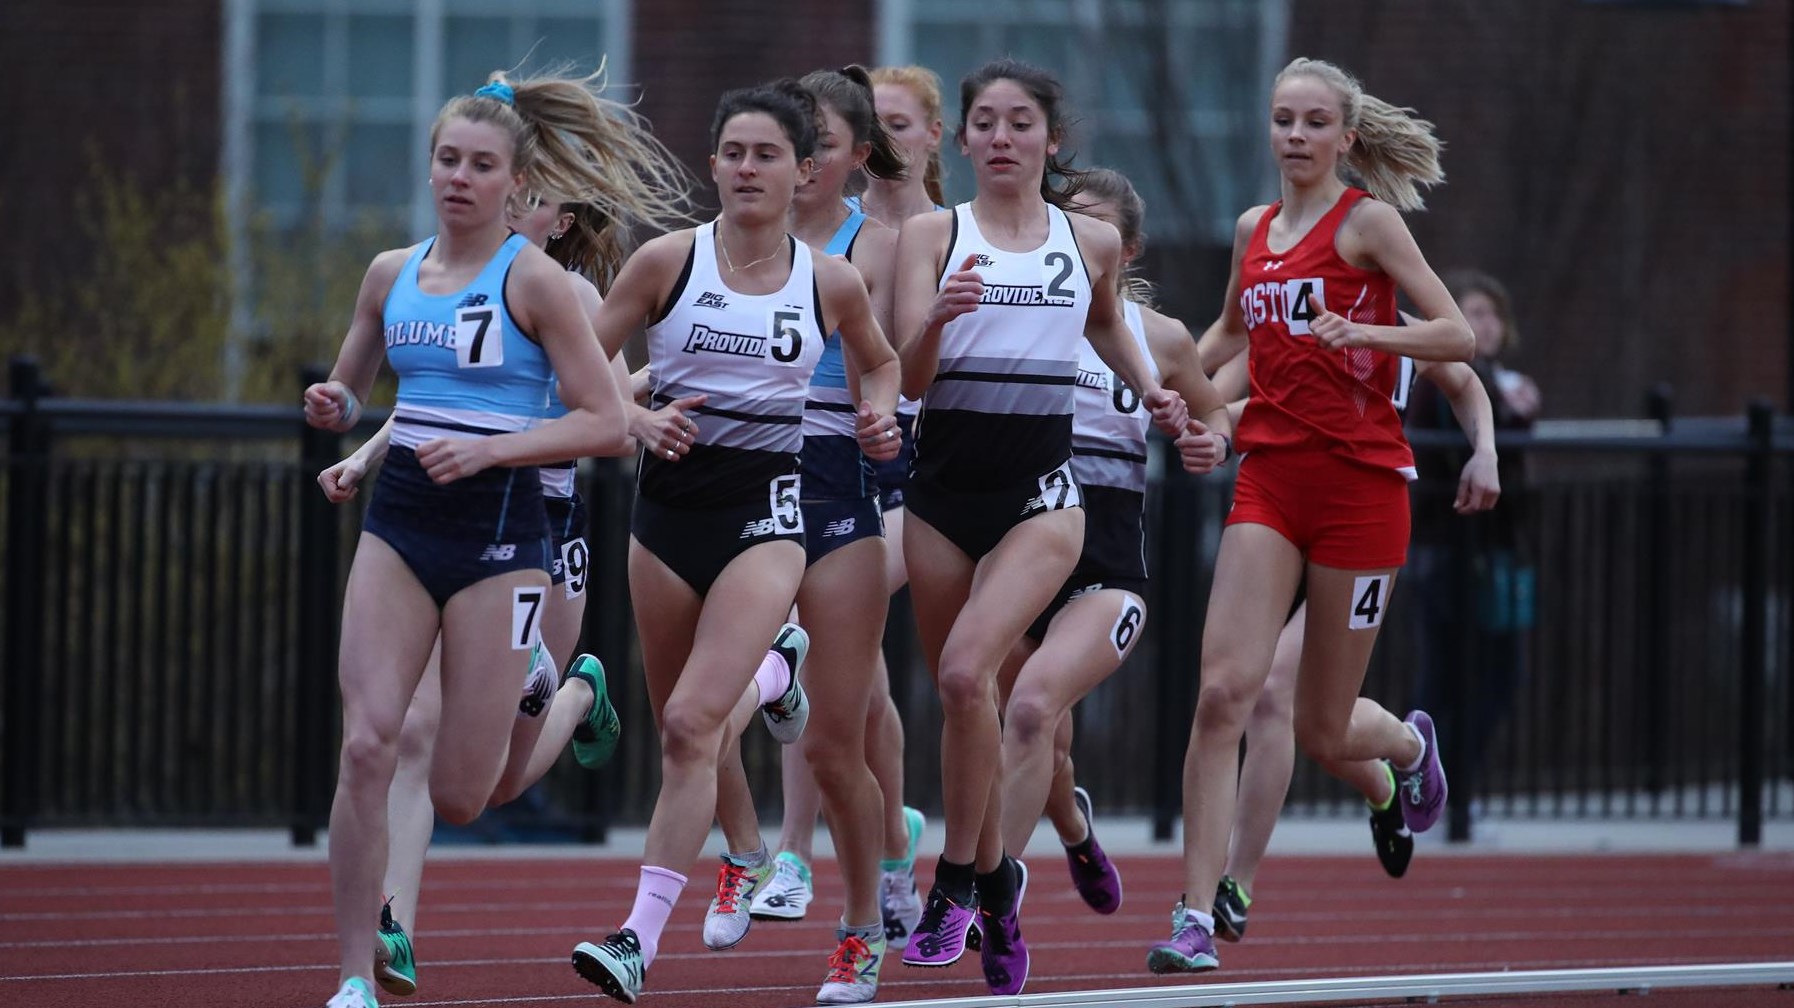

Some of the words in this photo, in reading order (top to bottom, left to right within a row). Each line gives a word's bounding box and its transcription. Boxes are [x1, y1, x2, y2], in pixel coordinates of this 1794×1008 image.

[701, 291, 725, 302] BIG
[1044, 252, 1075, 299] 2
[695, 298, 730, 310] EAST
[1292, 282, 1319, 325] 4
[461, 310, 493, 364] 7
[771, 311, 803, 363] 5
[1113, 372, 1139, 414] 6
[776, 479, 799, 530] 5
[822, 517, 855, 537] NB
[740, 518, 775, 539] NB
[480, 544, 516, 561] NB
[567, 541, 586, 593] 9
[518, 593, 542, 645] 7
[1354, 579, 1381, 624] 4
[1116, 606, 1141, 651] 6
